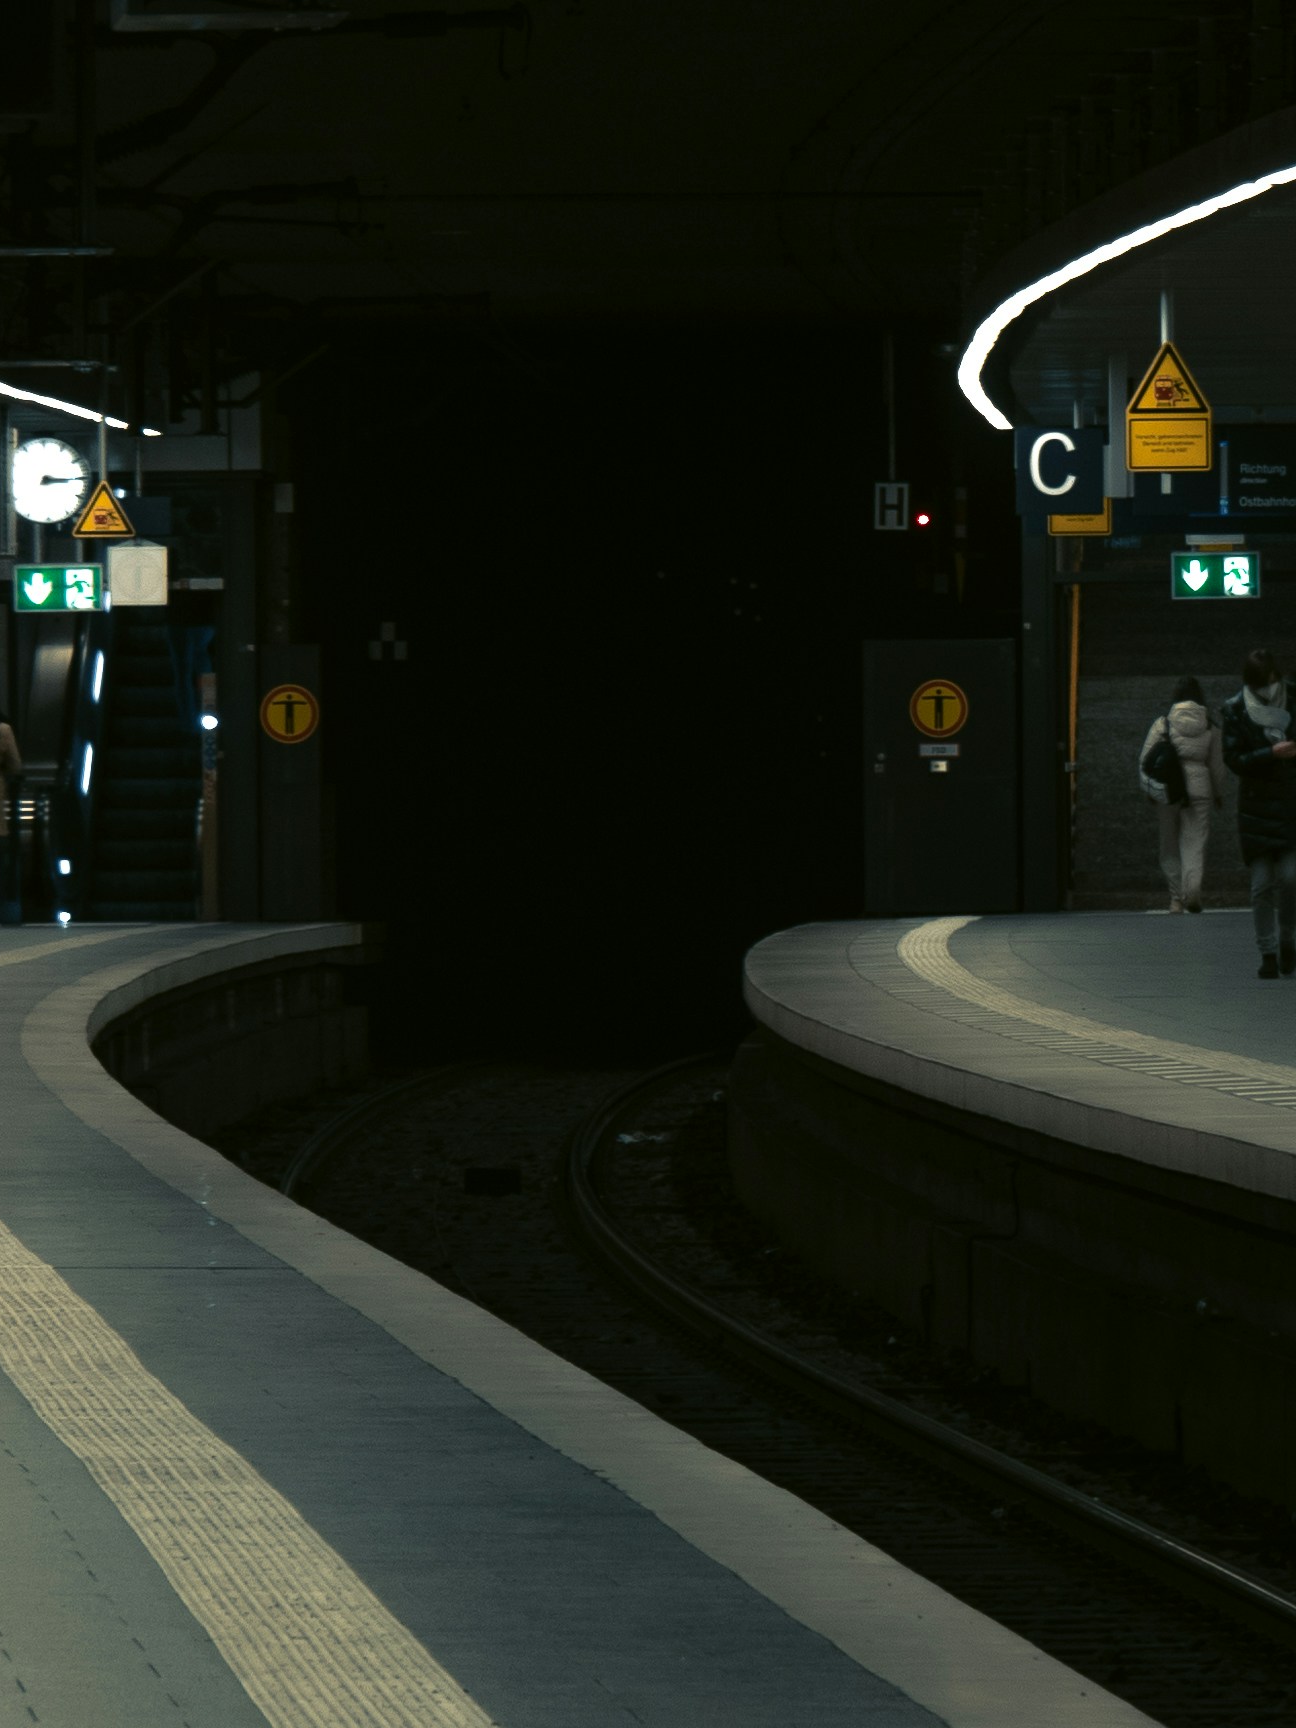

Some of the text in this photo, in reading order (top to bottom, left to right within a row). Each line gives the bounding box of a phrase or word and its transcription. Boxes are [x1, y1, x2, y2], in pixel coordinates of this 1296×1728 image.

[1029, 432, 1077, 496] C
[1239, 463, 1287, 476] Richtung
[879, 487, 904, 527] H
